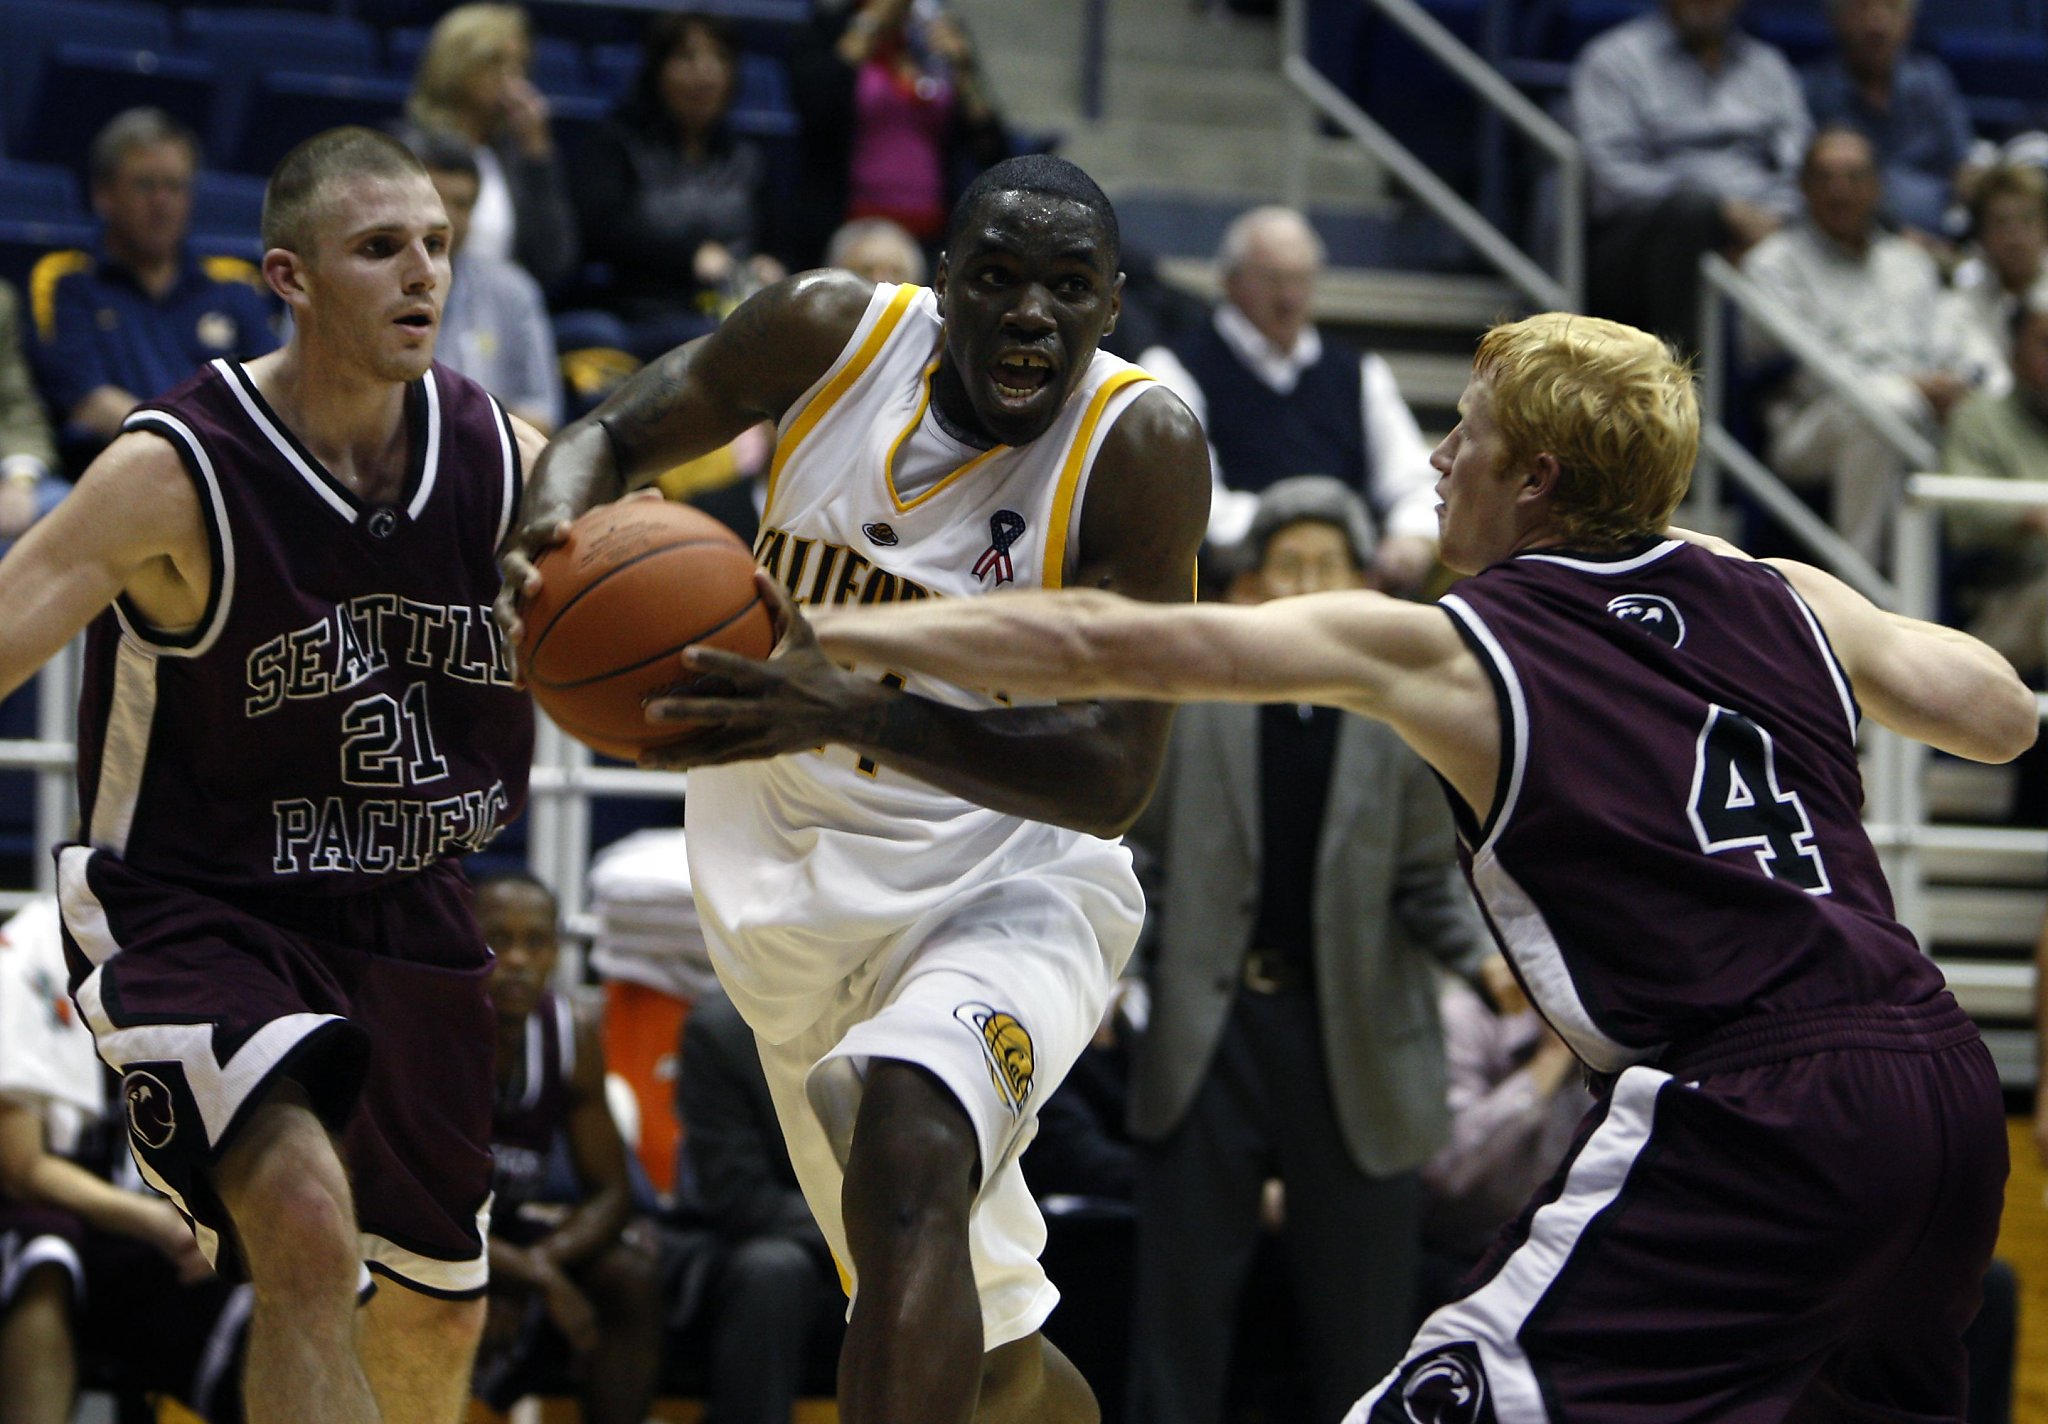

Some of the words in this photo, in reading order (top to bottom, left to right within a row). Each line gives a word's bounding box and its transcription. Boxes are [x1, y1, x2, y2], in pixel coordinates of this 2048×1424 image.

[340, 682, 449, 787] 21
[273, 779, 508, 874] PACIFIC
[1686, 702, 1832, 896] 4
